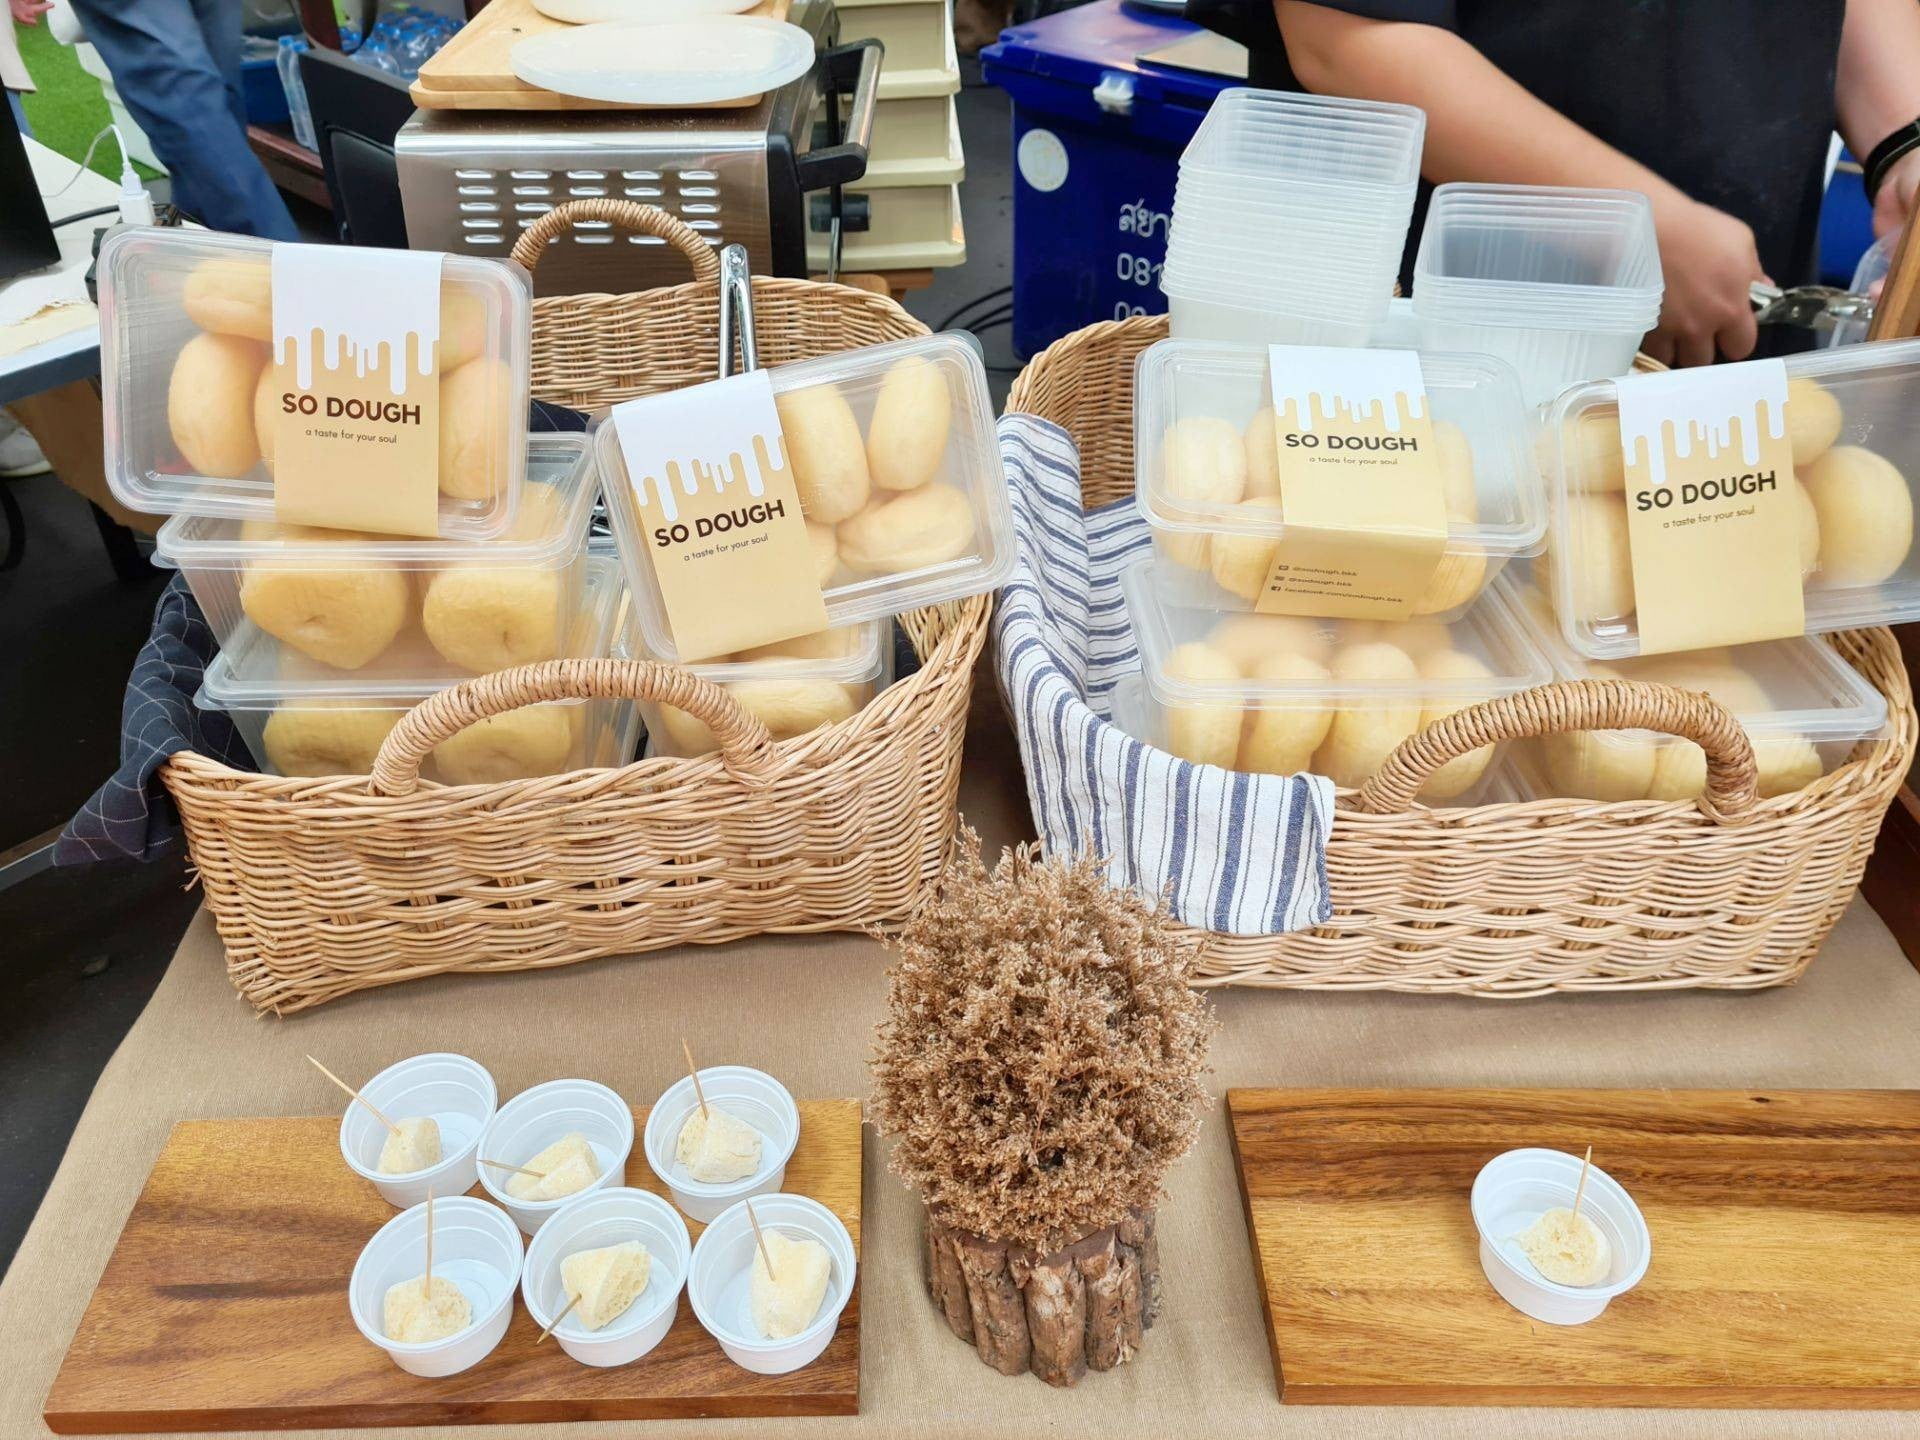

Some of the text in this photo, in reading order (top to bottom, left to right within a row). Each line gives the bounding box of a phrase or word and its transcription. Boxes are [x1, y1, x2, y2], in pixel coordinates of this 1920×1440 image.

[282, 392, 421, 425] SO DOUGH
[314, 428, 338, 438] taste
[341, 429, 354, 440] for
[356, 434, 376, 443] your
[378, 434, 397, 444] soul
[1285, 433, 1418, 451] SO DOUGH
[1318, 456, 1341, 464] taste
[1343, 457, 1356, 465] for
[1380, 458, 1398, 466] soul
[1636, 470, 1776, 511] SO DOUGH
[654, 499, 785, 547] SO DOUGH
[1663, 505, 1756, 529] a taste for your soul
[692, 548, 714, 560] taste
[716, 544, 729, 553] for
[730, 540, 749, 553] your
[751, 533, 769, 545] soul
